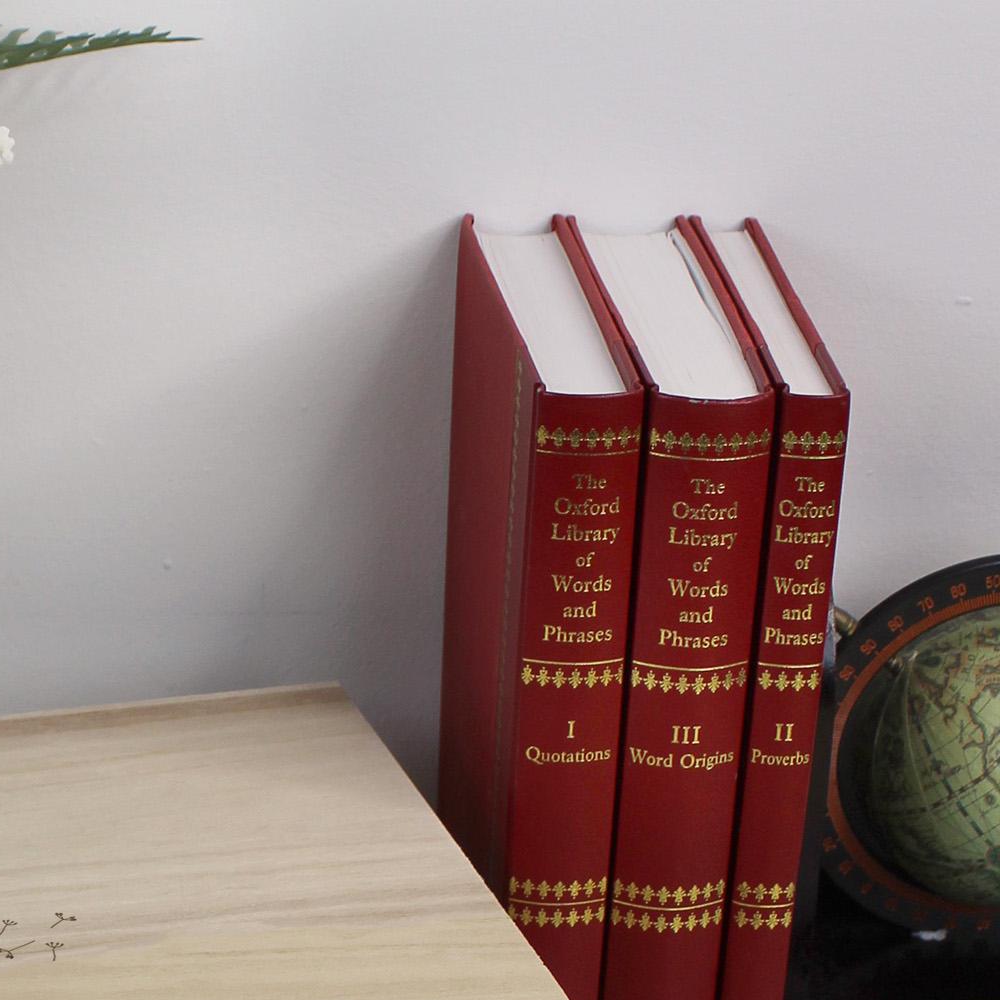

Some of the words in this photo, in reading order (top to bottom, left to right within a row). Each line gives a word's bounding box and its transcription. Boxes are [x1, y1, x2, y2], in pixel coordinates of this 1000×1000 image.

[572, 473, 607, 490] The
[690, 478, 726, 495] The
[795, 477, 825, 493] The
[554, 497, 620, 516] Oxford
[671, 501, 738, 521] Oxford
[778, 499, 835, 519] Oxford
[551, 523, 620, 544] Library
[668, 527, 738, 550] Library
[774, 525, 834, 547] Library
[576, 552, 595, 568] of
[693, 557, 712, 573] of
[795, 554, 813, 570] of
[552, 574, 612, 593] Words
[667, 578, 728, 598] Words
[773, 576, 826, 596] Words
[563, 601, 597, 618] and
[679, 607, 713, 624] and
[782, 604, 812, 621] and
[542, 625, 613, 643] Phrases
[658, 629, 728, 649] Phrases
[764, 626, 824, 646] Phrases
[567, 721, 576, 739] I
[671, 725, 701, 744] III
[775, 723, 794, 742] II
[525, 746, 611, 765] Quotations
[629, 747, 673, 768] Word
[680, 752, 734, 770] Origins
[751, 750, 810, 767] Proverbs
